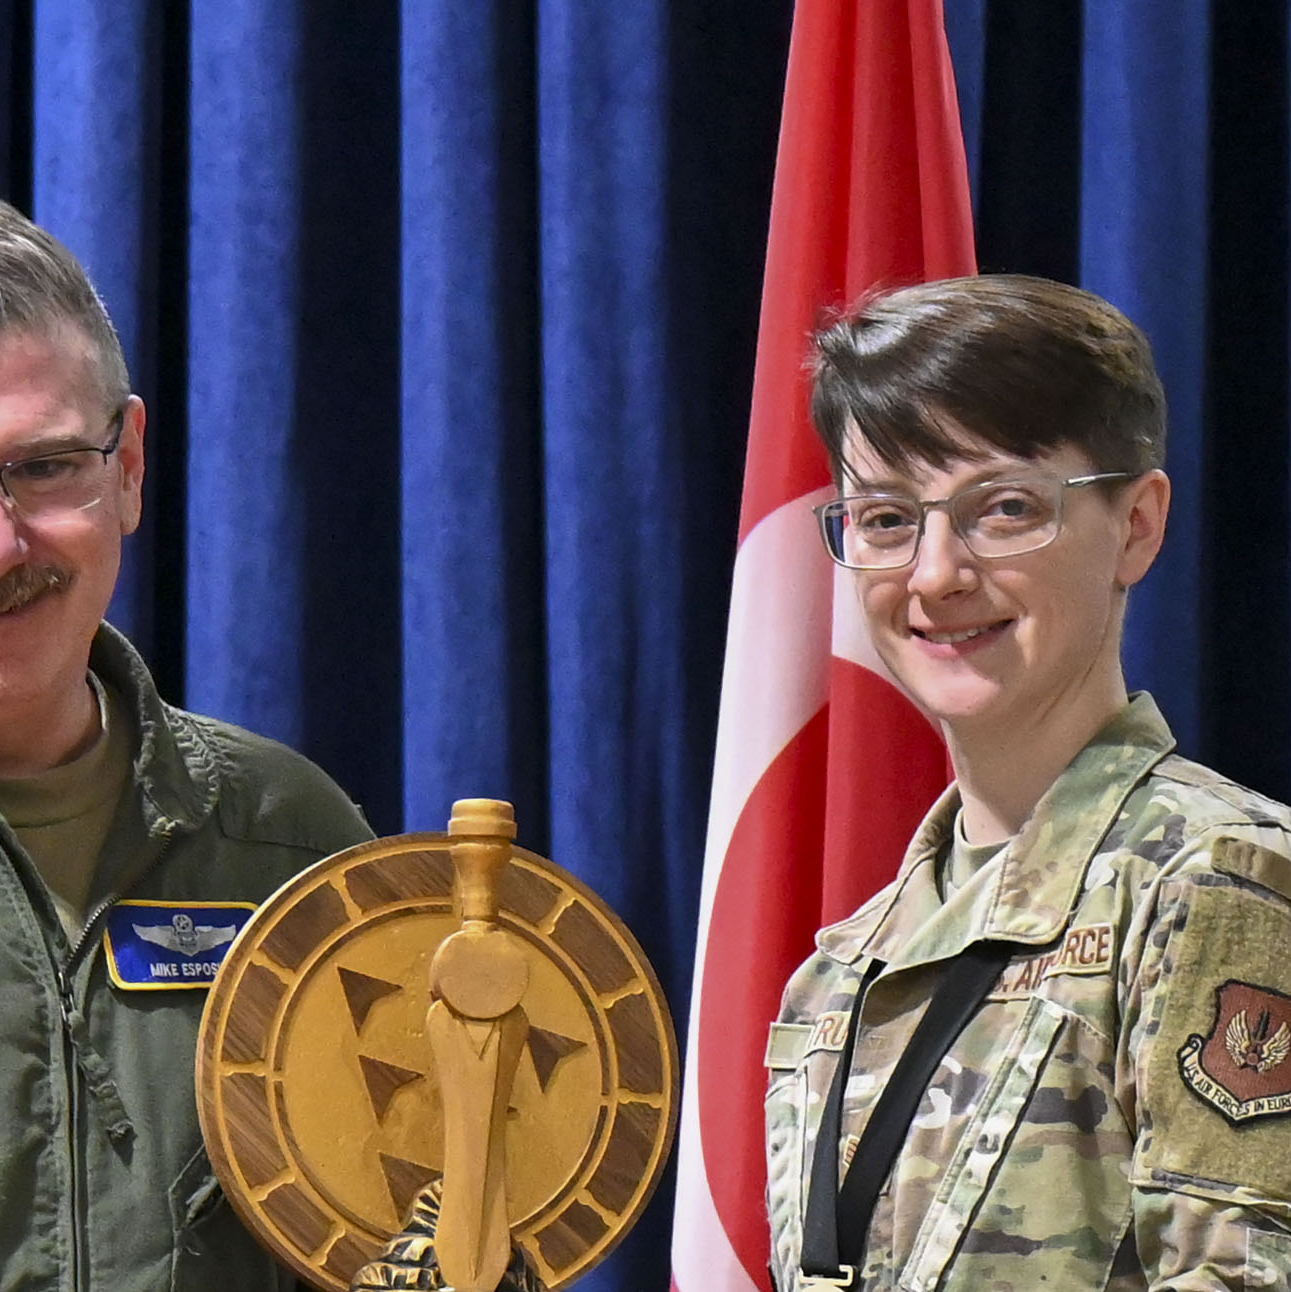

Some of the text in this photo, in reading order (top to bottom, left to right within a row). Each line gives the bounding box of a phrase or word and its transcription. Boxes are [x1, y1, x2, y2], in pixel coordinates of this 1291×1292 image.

[150, 963, 220, 977] MIKE ESPOS
[1195, 1078, 1212, 1095] AIR
[1212, 1089, 1250, 1117] FORCES
[1254, 1101, 1265, 1112] IN
